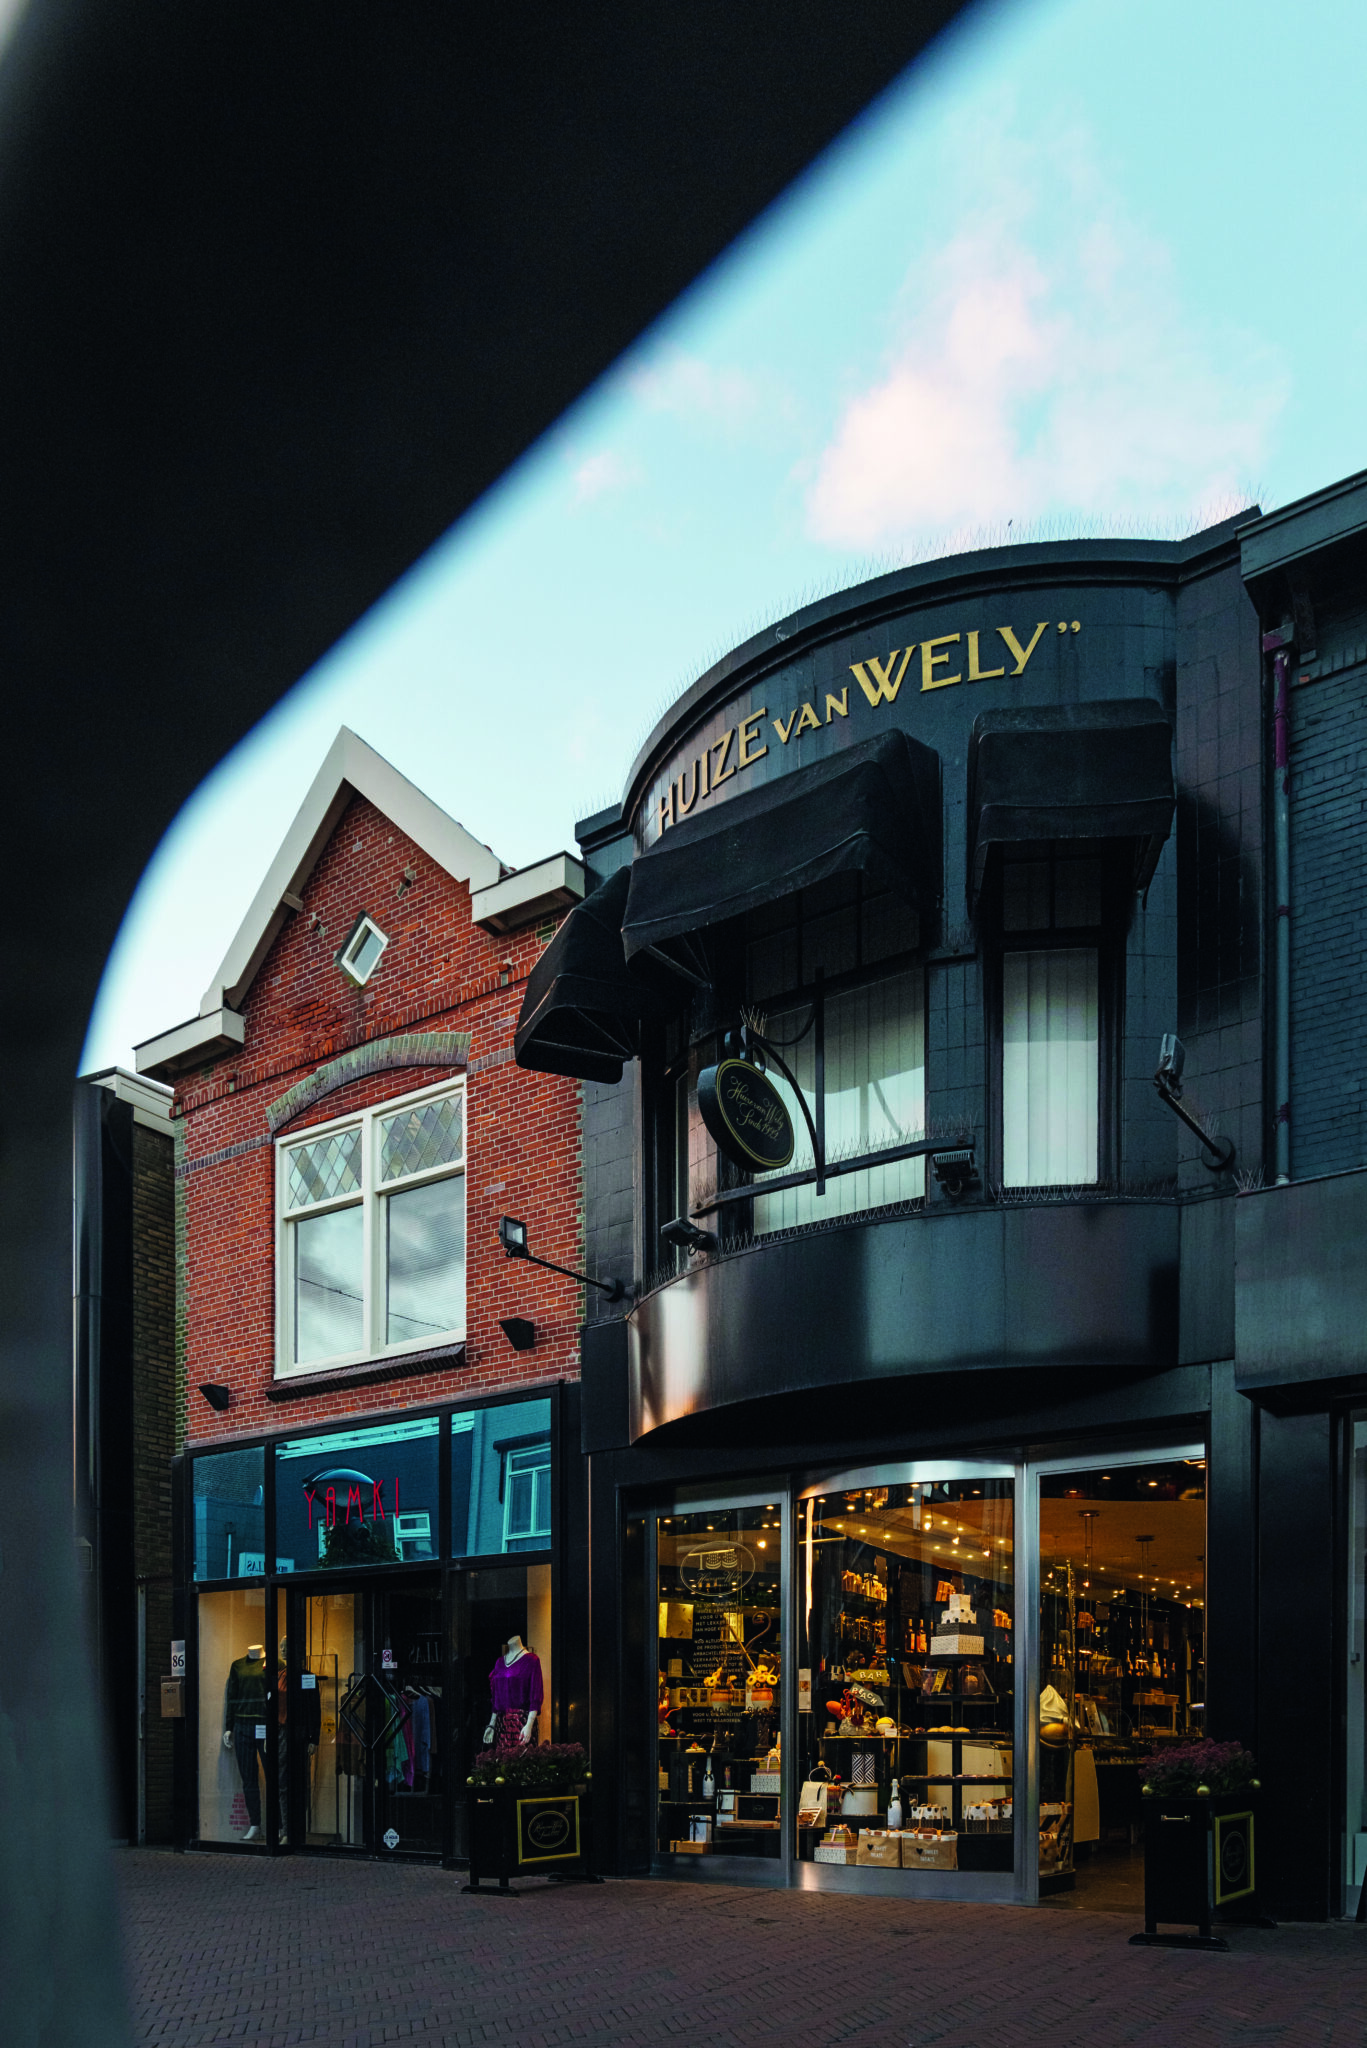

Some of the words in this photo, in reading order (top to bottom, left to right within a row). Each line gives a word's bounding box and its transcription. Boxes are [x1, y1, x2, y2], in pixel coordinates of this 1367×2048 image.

[657, 707, 768, 837] HUIZE
[772, 687, 848, 744] VAN
[727, 1075, 754, 1105] Huize
[304, 1477, 399, 1530] YAMKI
[172, 1655, 184, 1667] 86
[859, 1671, 882, 1680] BAR
[851, 1687, 878, 1705] BEACH
